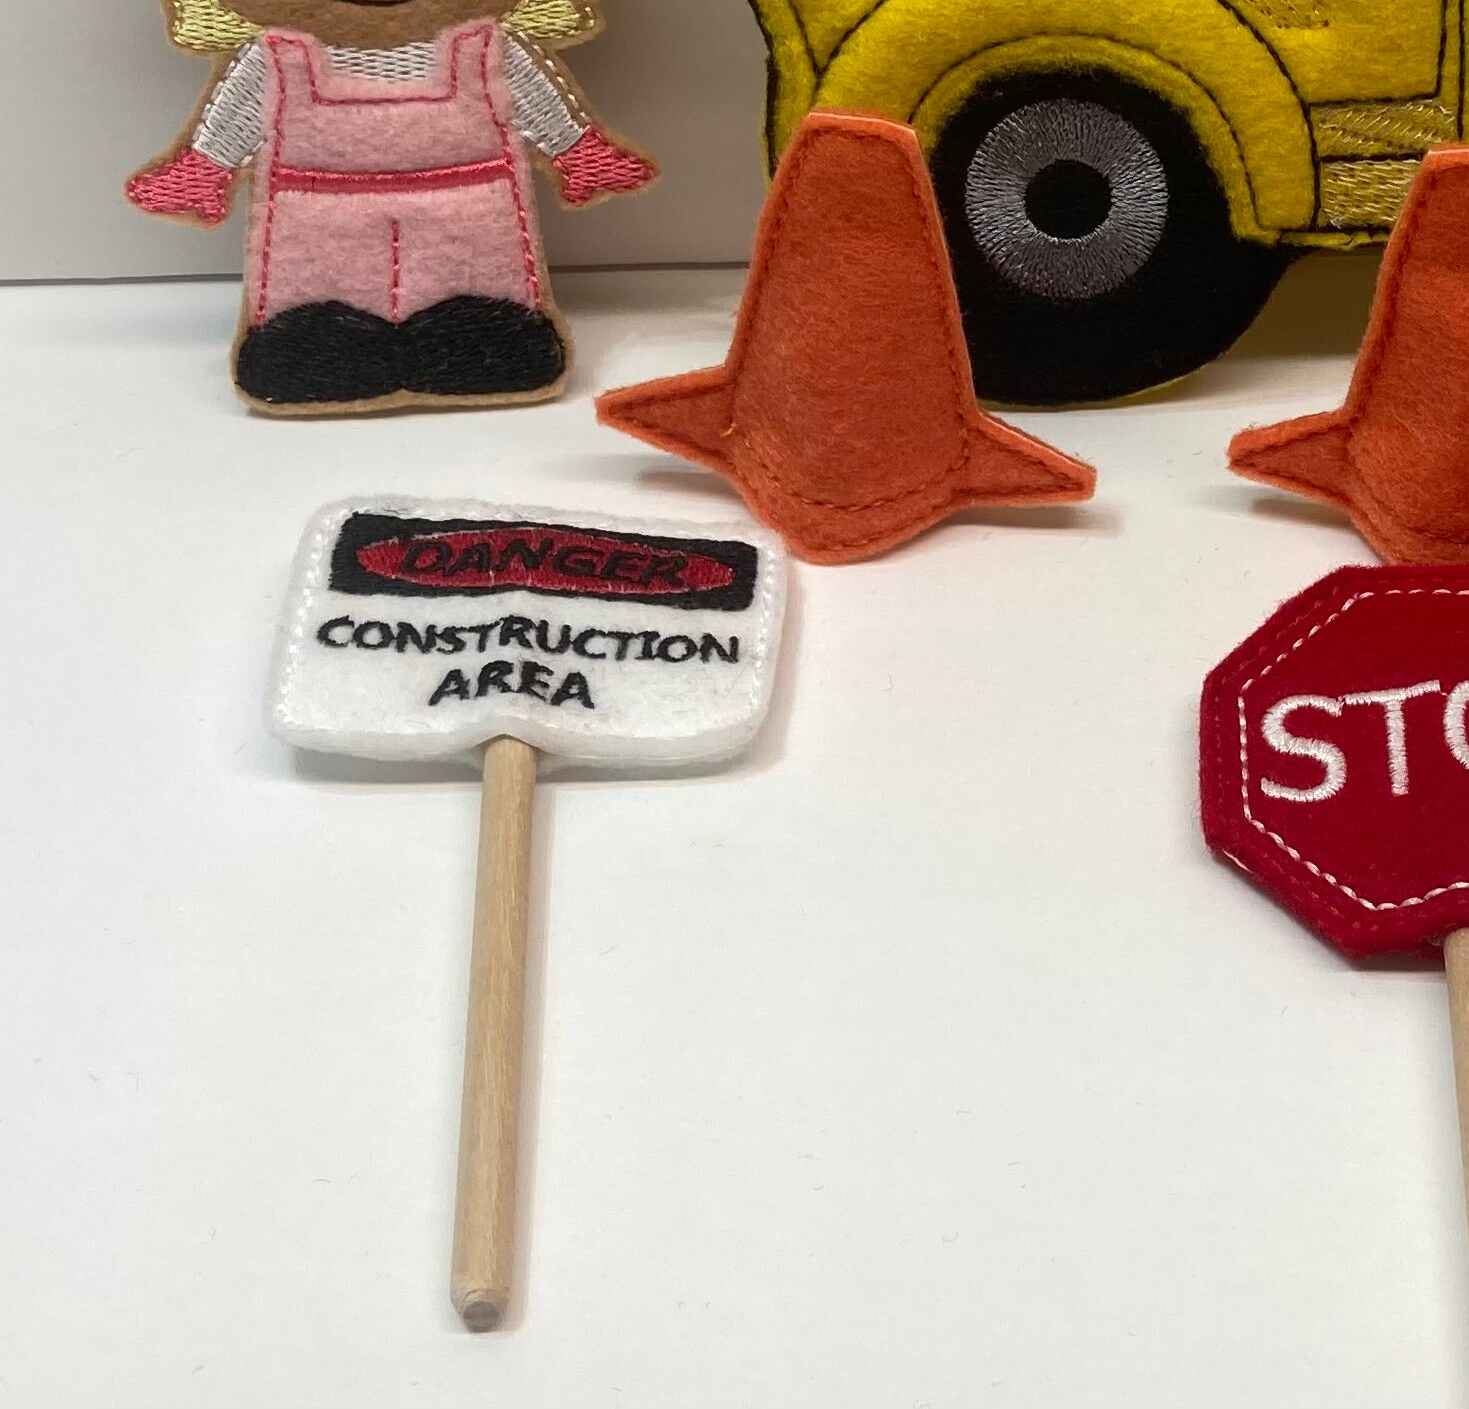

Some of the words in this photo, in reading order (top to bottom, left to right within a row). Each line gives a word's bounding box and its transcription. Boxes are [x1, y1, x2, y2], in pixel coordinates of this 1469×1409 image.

[400, 537, 686, 588] DANGER
[317, 615, 738, 663] CONSTRUCTION
[428, 661, 594, 709] AREA
